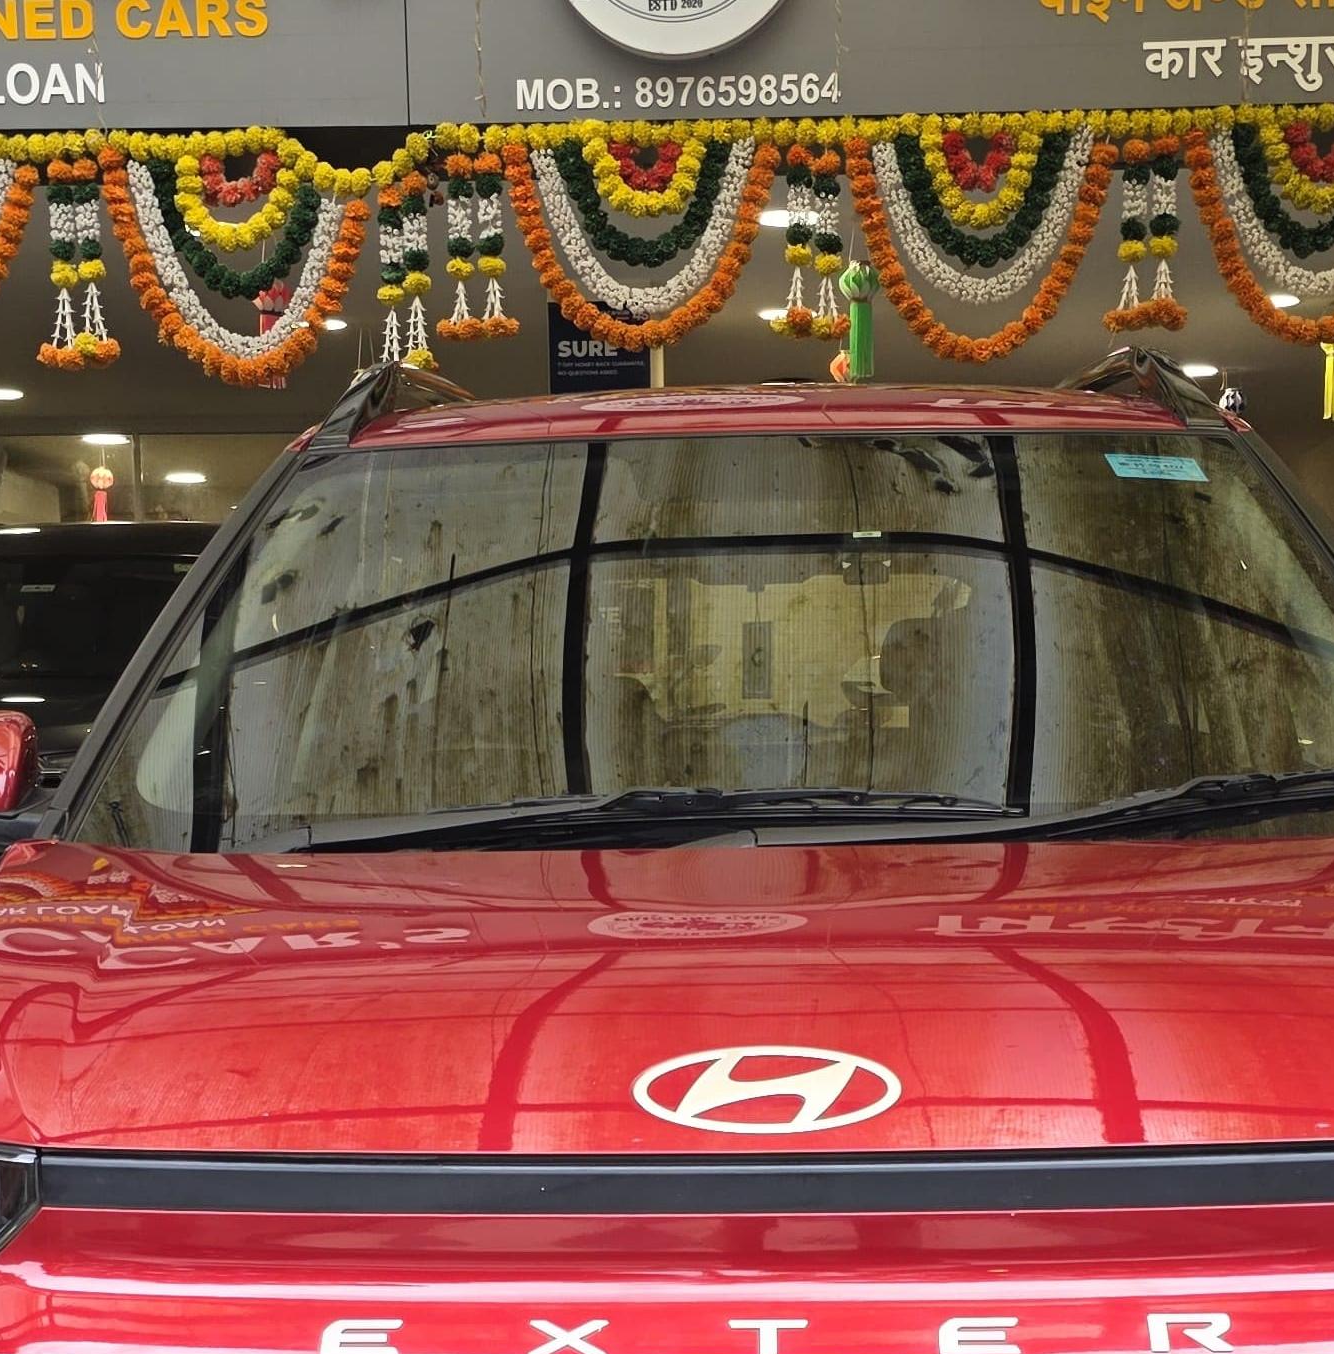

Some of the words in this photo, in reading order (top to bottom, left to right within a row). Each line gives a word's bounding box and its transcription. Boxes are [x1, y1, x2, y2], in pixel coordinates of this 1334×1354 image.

[116, 0, 268, 39] CARS
[1142, 38, 1227, 80] कार
[516, 78, 622, 111] MOB.:
[635, 72, 839, 109] 8976598564
